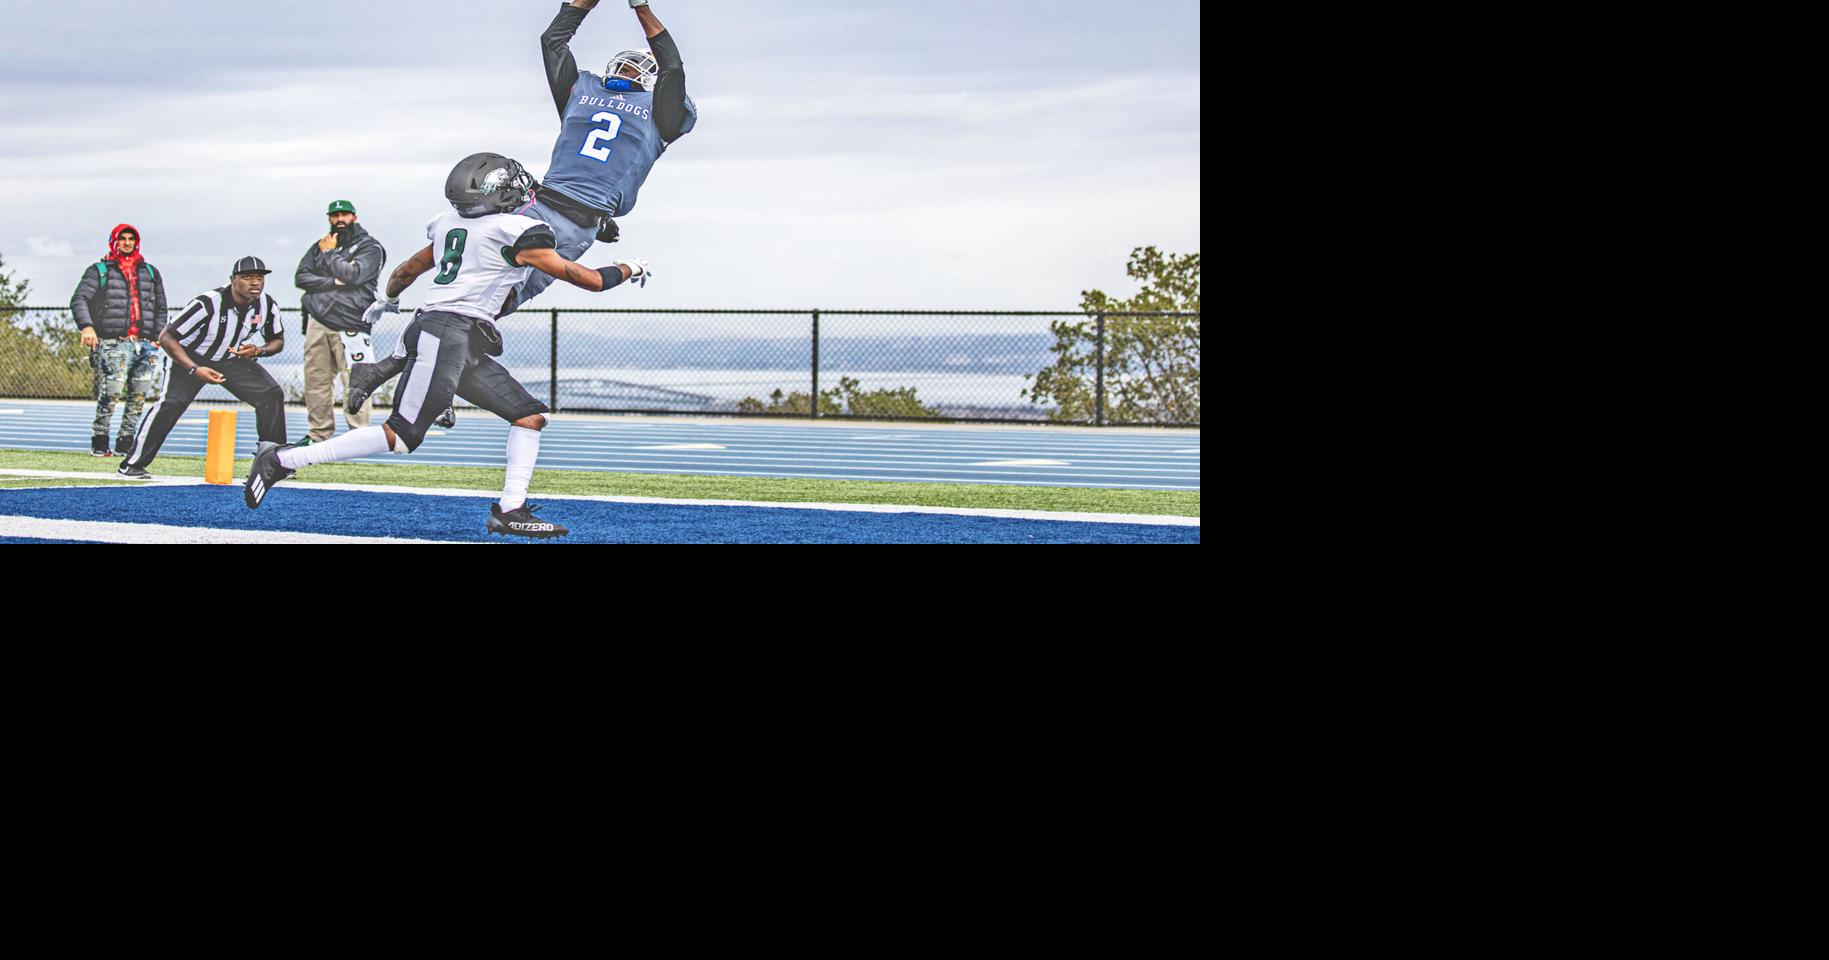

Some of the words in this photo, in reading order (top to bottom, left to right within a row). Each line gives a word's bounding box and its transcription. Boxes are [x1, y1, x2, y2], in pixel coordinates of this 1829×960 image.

[579, 95, 650, 120] BULLDOGS
[578, 110, 624, 163] 2
[335, 201, 343, 209] L
[433, 227, 468, 285] 8
[508, 521, 554, 531] ADIZERO
